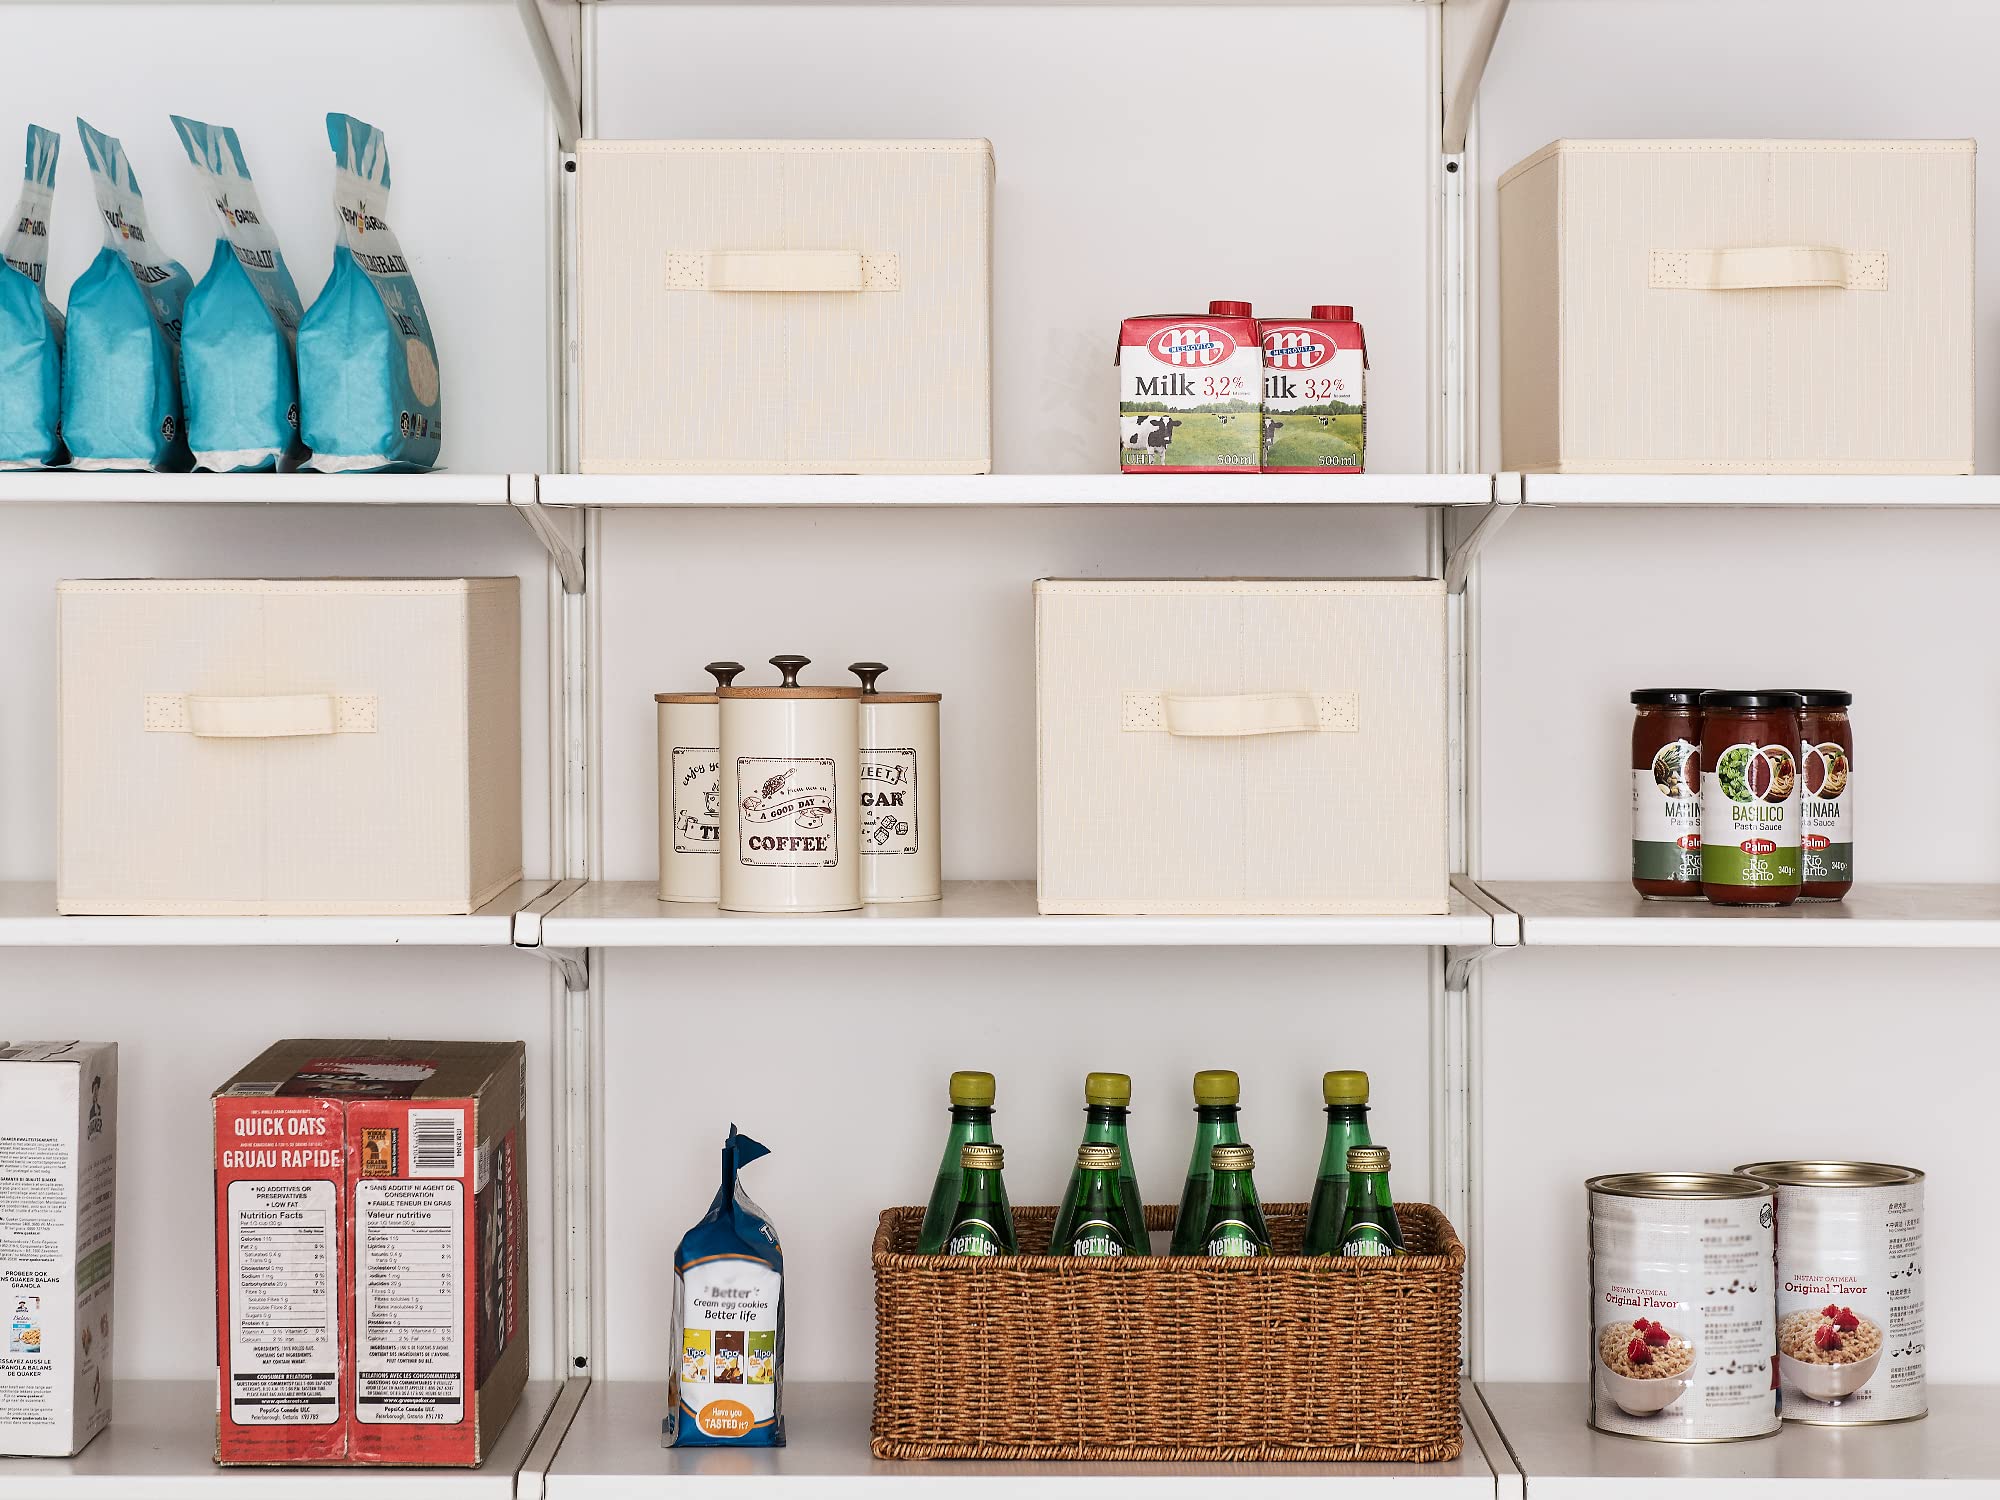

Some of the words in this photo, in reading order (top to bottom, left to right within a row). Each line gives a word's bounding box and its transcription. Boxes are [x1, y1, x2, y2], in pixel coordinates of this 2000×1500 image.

[1171, 343, 1211, 353] MLEKOVITA
[1273, 346, 1313, 356] MLEKOVITA
[1135, 373, 1196, 397] Milk
[1125, 454, 1154, 465] UHT
[683, 764, 705, 786] enjoy
[861, 767, 893, 779] EET
[771, 805, 794, 818] GOOD
[798, 799, 815, 808] DAY
[1732, 806, 1784, 822] BASILICO
[1759, 822, 1782, 831] Sauce
[1813, 819, 1835, 827] Sauce
[748, 836, 828, 851] COFFEE
[1745, 843, 1772, 852] Palmi
[1742, 868, 1774, 881] Santo
[234, 1117, 284, 1137] QUICK
[288, 1117, 326, 1136] OATS
[223, 1150, 277, 1168] GRUAU
[281, 1149, 340, 1168] RAPIDE
[367, 1211, 394, 1219] Valeur
[396, 1211, 432, 1219] nutritive
[711, 1286, 751, 1299] Better
[1611, 1285, 1635, 1294] INSTANT
[1635, 1288, 1667, 1297] OATMEAL
[1784, 1282, 1830, 1295] Original
[1832, 1284, 1868, 1294] Flavor
[693, 1298, 719, 1307] Cream
[721, 1301, 736, 1310] egg
[737, 1300, 768, 1309] cookies
[1605, 1292, 1641, 1307] Original
[1643, 1297, 1678, 1308] Flavor
[705, 1309, 738, 1320] Better
[739, 1310, 757, 1322] life
[687, 1347, 705, 1358] Tipo
[720, 1348, 739, 1359] Tipo
[754, 1349, 772, 1360] Tipo
[712, 1407, 729, 1416] Have
[730, 1409, 742, 1419] you
[705, 1419, 737, 1429] TASTED
[738, 1421, 749, 1430] it?
